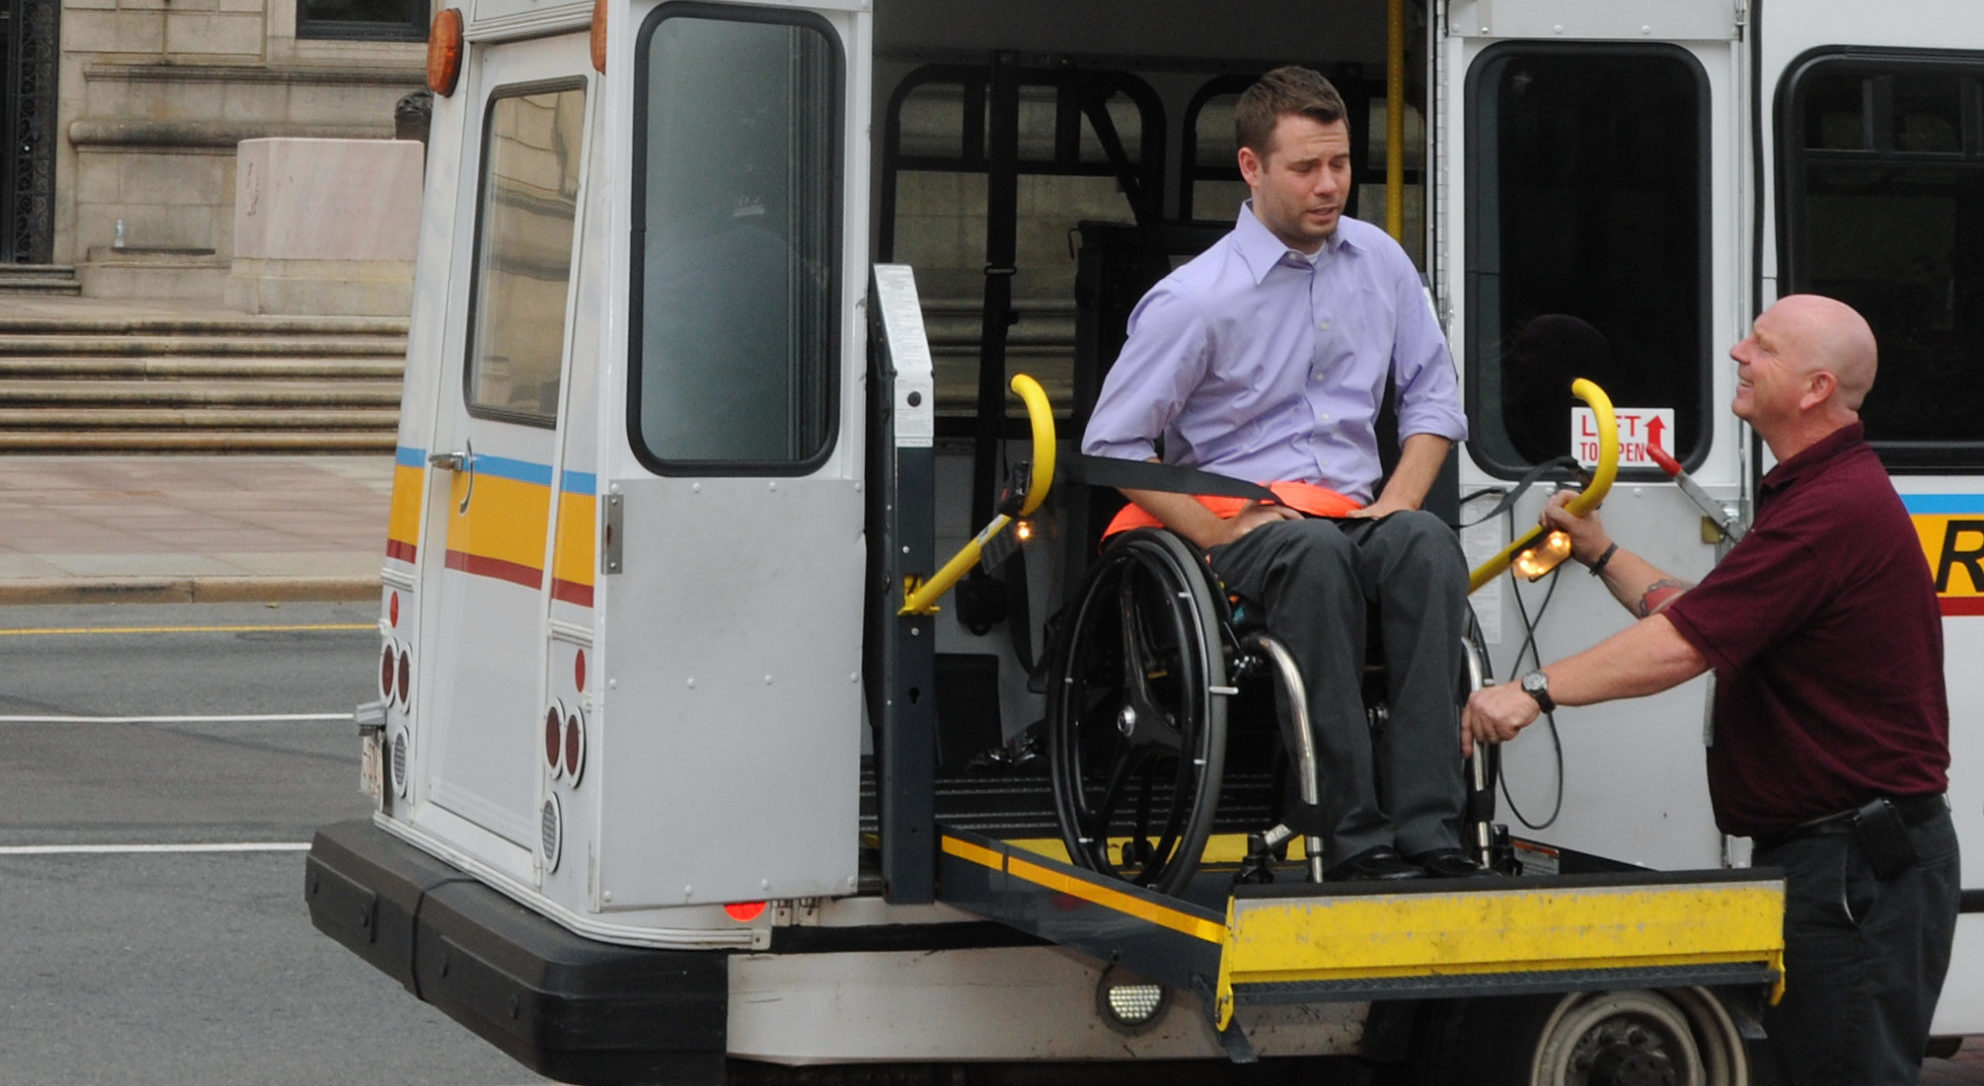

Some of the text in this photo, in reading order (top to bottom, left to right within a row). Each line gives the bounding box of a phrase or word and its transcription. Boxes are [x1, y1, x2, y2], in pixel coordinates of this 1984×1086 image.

[1582, 415, 1641, 437] LT
[1580, 442, 1645, 462] TO PEN
